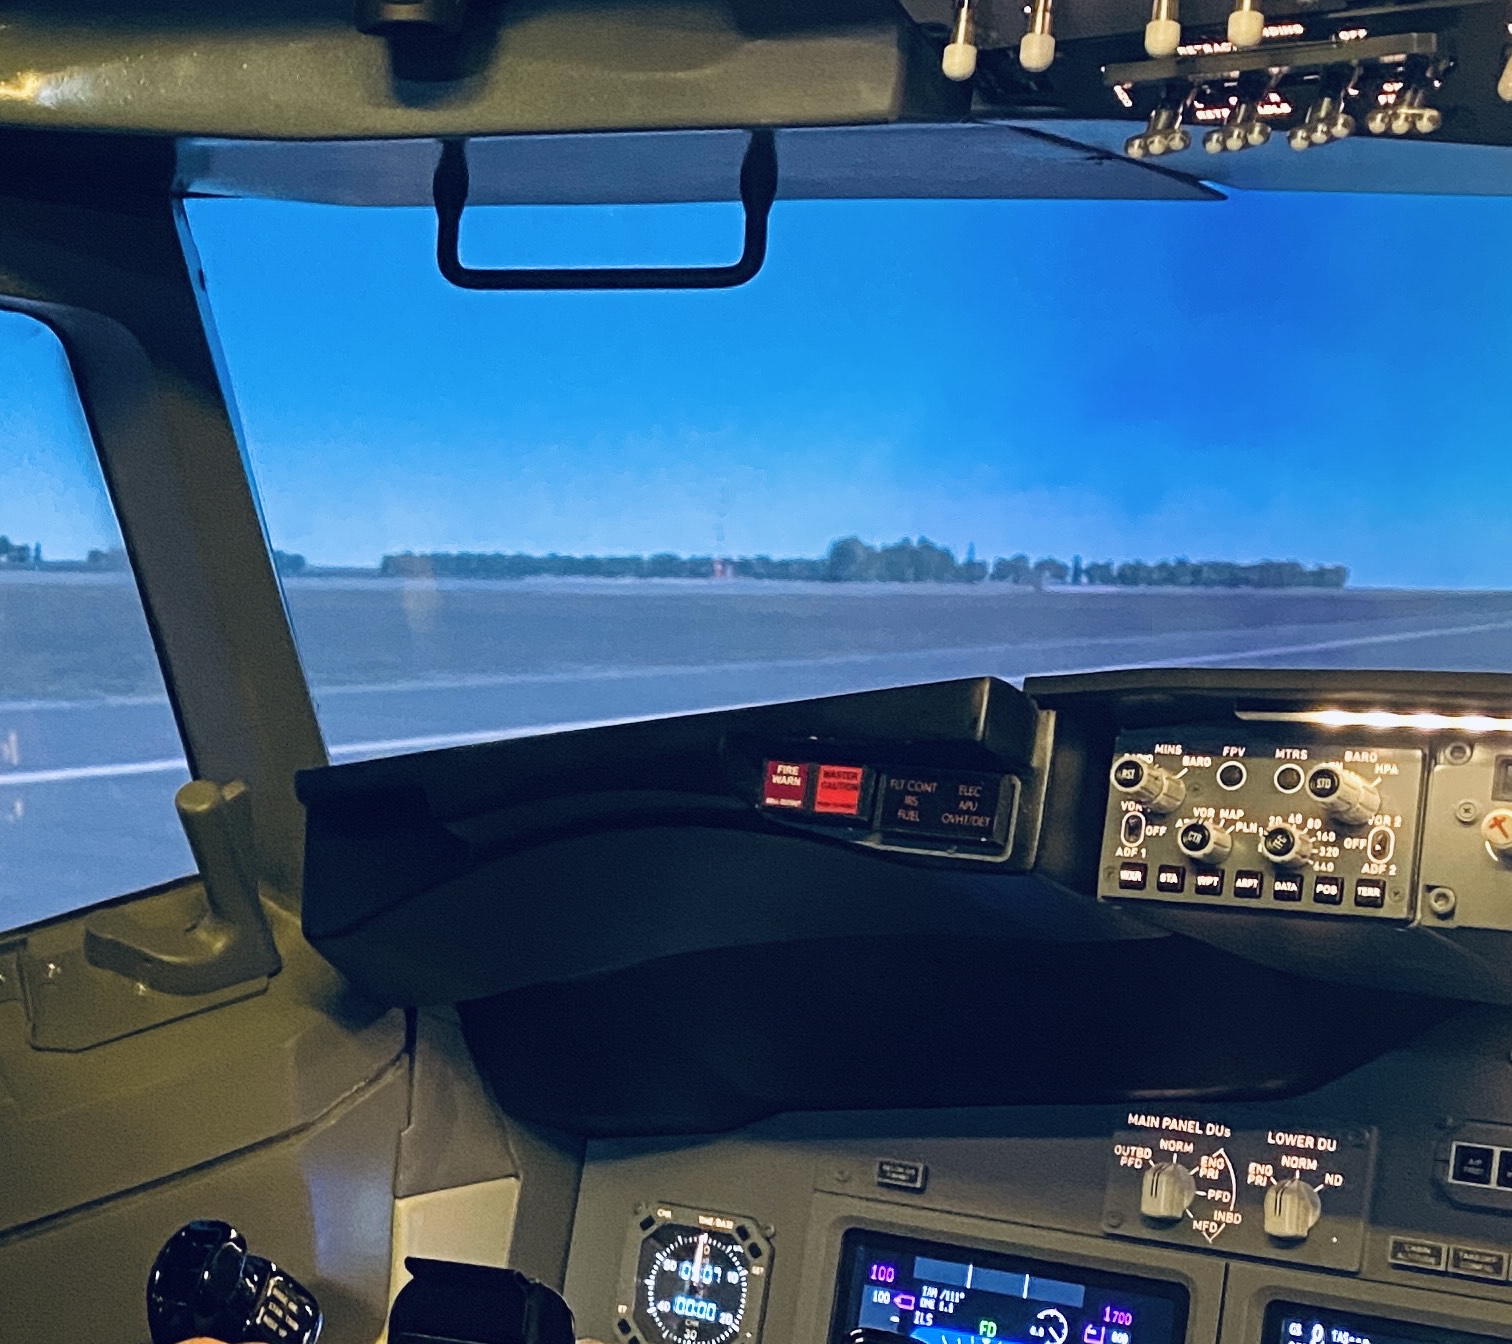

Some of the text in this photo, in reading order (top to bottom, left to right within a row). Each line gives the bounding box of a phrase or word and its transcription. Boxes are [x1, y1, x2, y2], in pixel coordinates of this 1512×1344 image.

[1154, 744, 1182, 755] MINS
[1222, 746, 1246, 757] FPV
[1275, 748, 1308, 760] MTRS
[1182, 756, 1211, 767] BARO
[1344, 750, 1378, 763] BARO
[777, 764, 799, 776] FIRE
[1374, 764, 1399, 775] HPA
[772, 775, 801, 786] WARN
[907, 780, 937, 793] CONT
[958, 785, 982, 797] ELEC
[1193, 807, 1244, 819] VOR MAP
[1288, 813, 1303, 825] 40
[1145, 826, 1167, 836] OFF
[1236, 821, 1257, 834] PLN
[1316, 831, 1336, 842] 160
[1343, 838, 1367, 849] OFF
[1115, 846, 1147, 858] ADF 1
[1318, 846, 1339, 857] 320
[1361, 863, 1397, 875] ADF 2
[1275, 880, 1298, 892] DATA
[1128, 1113, 1231, 1138] MAIN PANEL DUs
[1159, 1138, 1194, 1153] NORM
[1267, 1131, 1337, 1152] LOWER DU
[1114, 1145, 1152, 1160] OUTBD
[1120, 1157, 1143, 1169] PFD
[1200, 1156, 1225, 1170] ENG
[1281, 1155, 1317, 1170] NORM
[1199, 1167, 1219, 1180] PRI
[1248, 1162, 1273, 1176] ENG
[1247, 1174, 1267, 1186] PRI
[1325, 1173, 1343, 1186] ND
[1207, 1189, 1231, 1203] PFD
[1213, 1209, 1242, 1225] INBD
[1192, 1219, 1218, 1232] MFD
[870, 1264, 895, 1283] 100
[872, 1289, 890, 1304] 100
[913, 1311, 933, 1326] ILS
[1104, 1306, 1133, 1326] 1700
[684, 1328, 697, 1340] 30
[979, 1320, 997, 1338] FD
